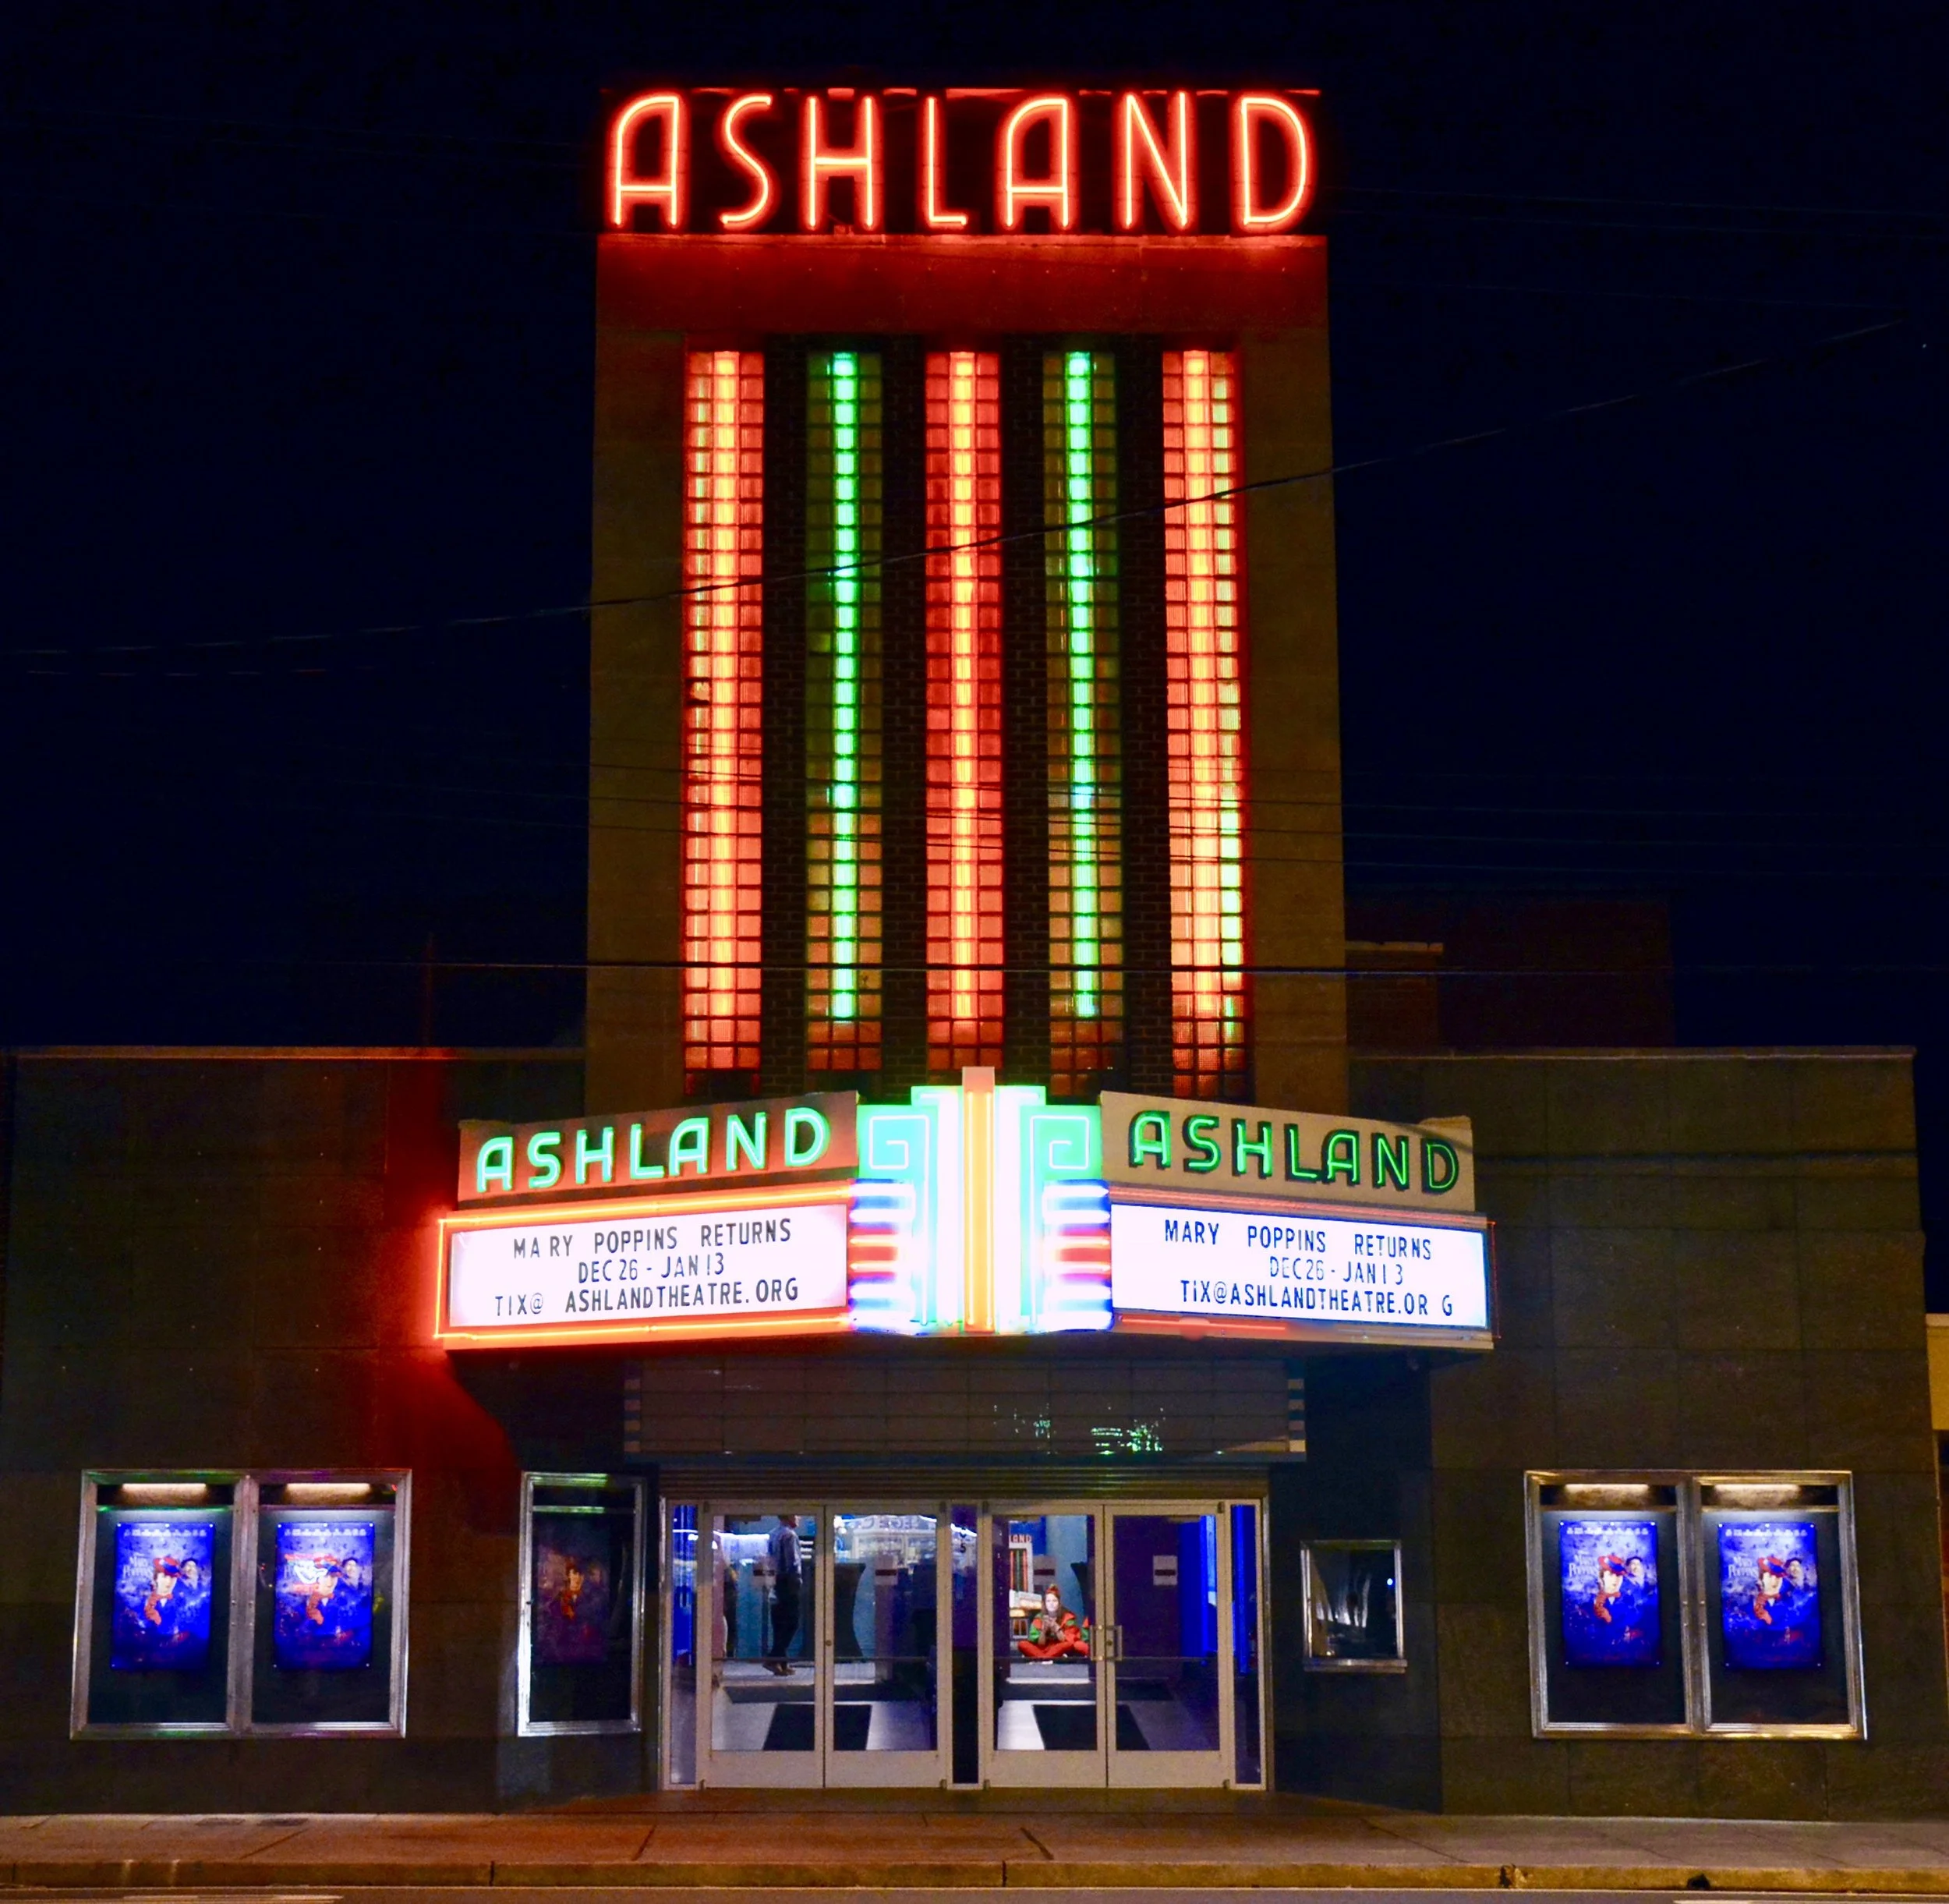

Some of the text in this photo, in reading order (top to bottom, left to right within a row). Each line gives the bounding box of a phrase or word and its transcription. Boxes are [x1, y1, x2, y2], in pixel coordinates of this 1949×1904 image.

[609, 90, 1311, 230] ASHLAND
[475, 1106, 831, 1194] ASHLAND
[1129, 1109, 1460, 1194] ASHLAND
[513, 1217, 792, 1259] MARY POPPINS RETURNS
[1164, 1219, 1432, 1261] MARY POPPINS RETURNS
